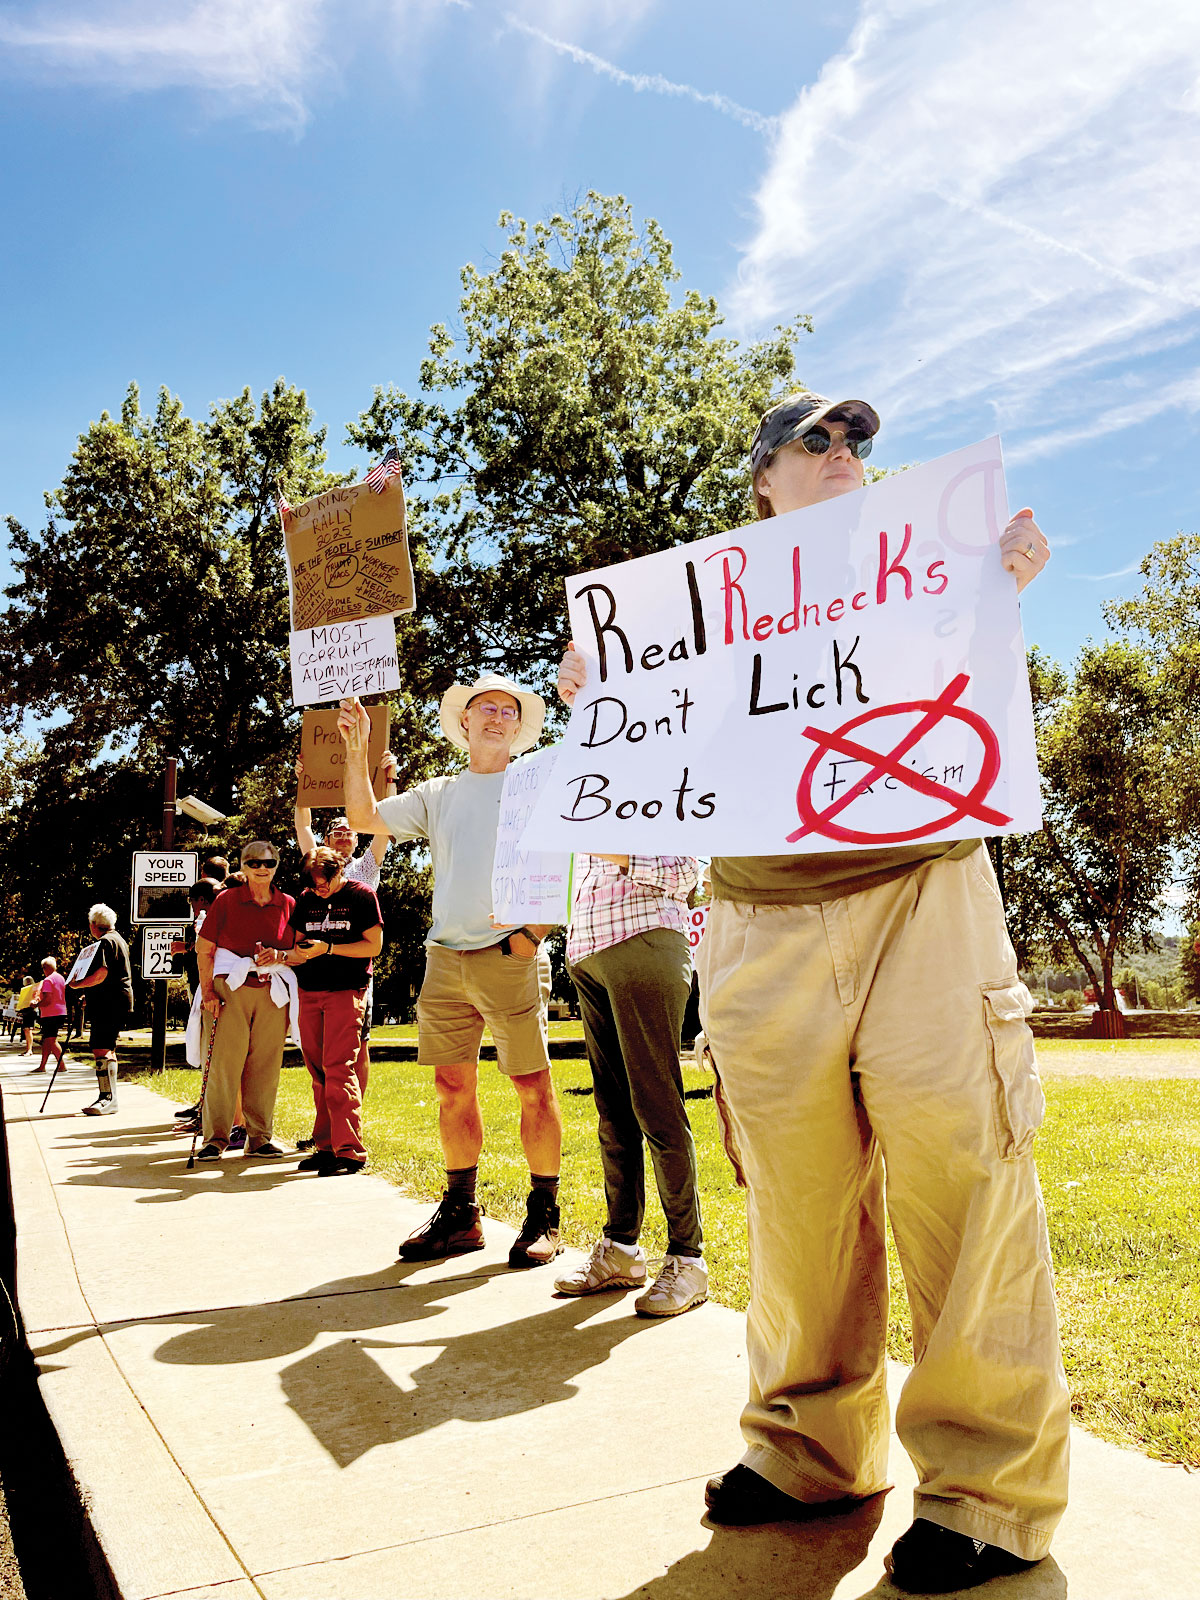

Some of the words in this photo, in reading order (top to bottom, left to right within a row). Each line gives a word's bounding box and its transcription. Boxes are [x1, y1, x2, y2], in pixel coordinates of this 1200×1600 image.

[289, 504, 310, 521] NO
[317, 488, 359, 510] KINGS
[313, 504, 354, 534] RALLY
[316, 524, 352, 548] 2025
[294, 562, 307, 576] WE
[308, 555, 323, 569] THE
[324, 539, 363, 558] PEOPLE
[362, 551, 400, 577] WORKERS
[360, 563, 394, 583] RIGHTS
[299, 596, 334, 631] DUCATION
[335, 596, 352, 607] DUE
[311, 622, 368, 648] MOST
[574, 560, 707, 682] Real
[297, 637, 376, 667] CORRUPT
[302, 650, 397, 683] ADMINISTRATION
[318, 670, 386, 700] EVER!!
[580, 687, 695, 749] Don't
[330, 753, 347, 765] ou
[560, 767, 716, 822] Boots
[144, 872, 186, 882] SPEED
[148, 859, 184, 869] YOUR
[150, 943, 170, 951] LIMI
[149, 952, 173, 974] 25
